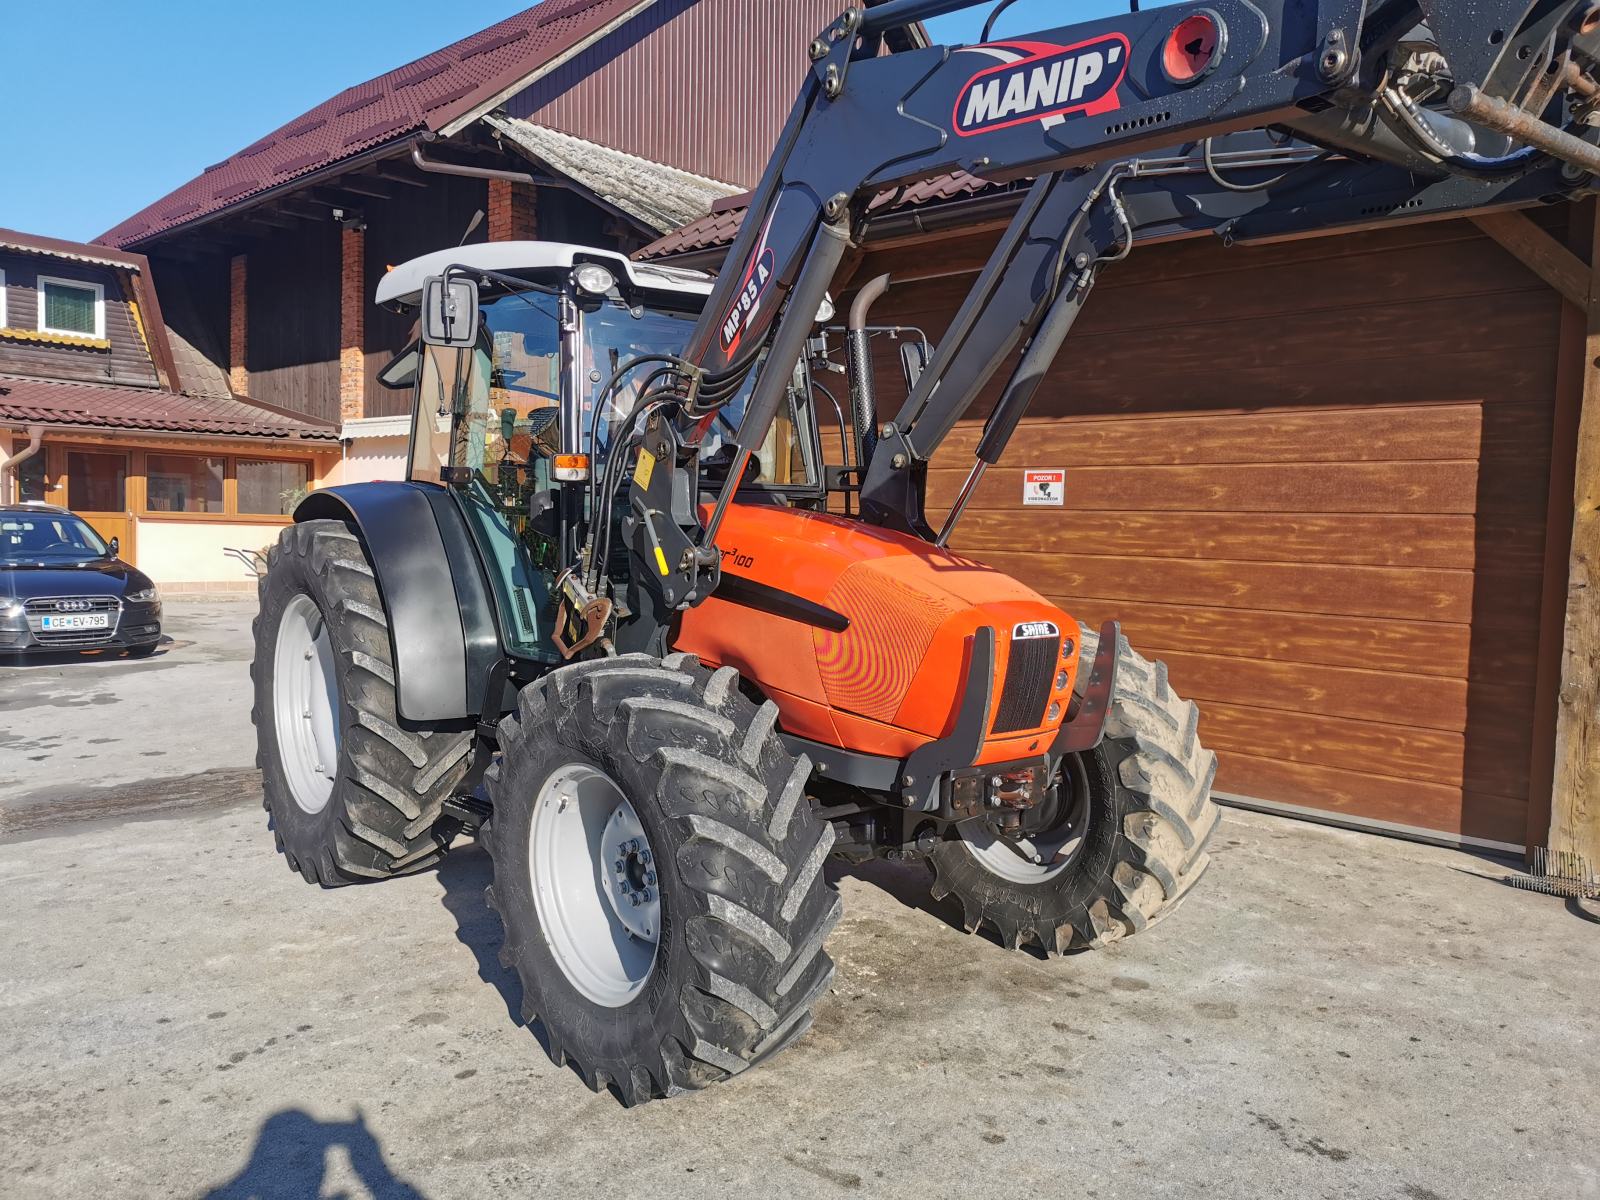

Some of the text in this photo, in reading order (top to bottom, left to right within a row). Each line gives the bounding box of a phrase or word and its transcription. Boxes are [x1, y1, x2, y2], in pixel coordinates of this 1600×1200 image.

[723, 263, 770, 344] MP'85 A
[52, 616, 105, 627] CE EV-795
[1021, 623, 1050, 637] SAME
